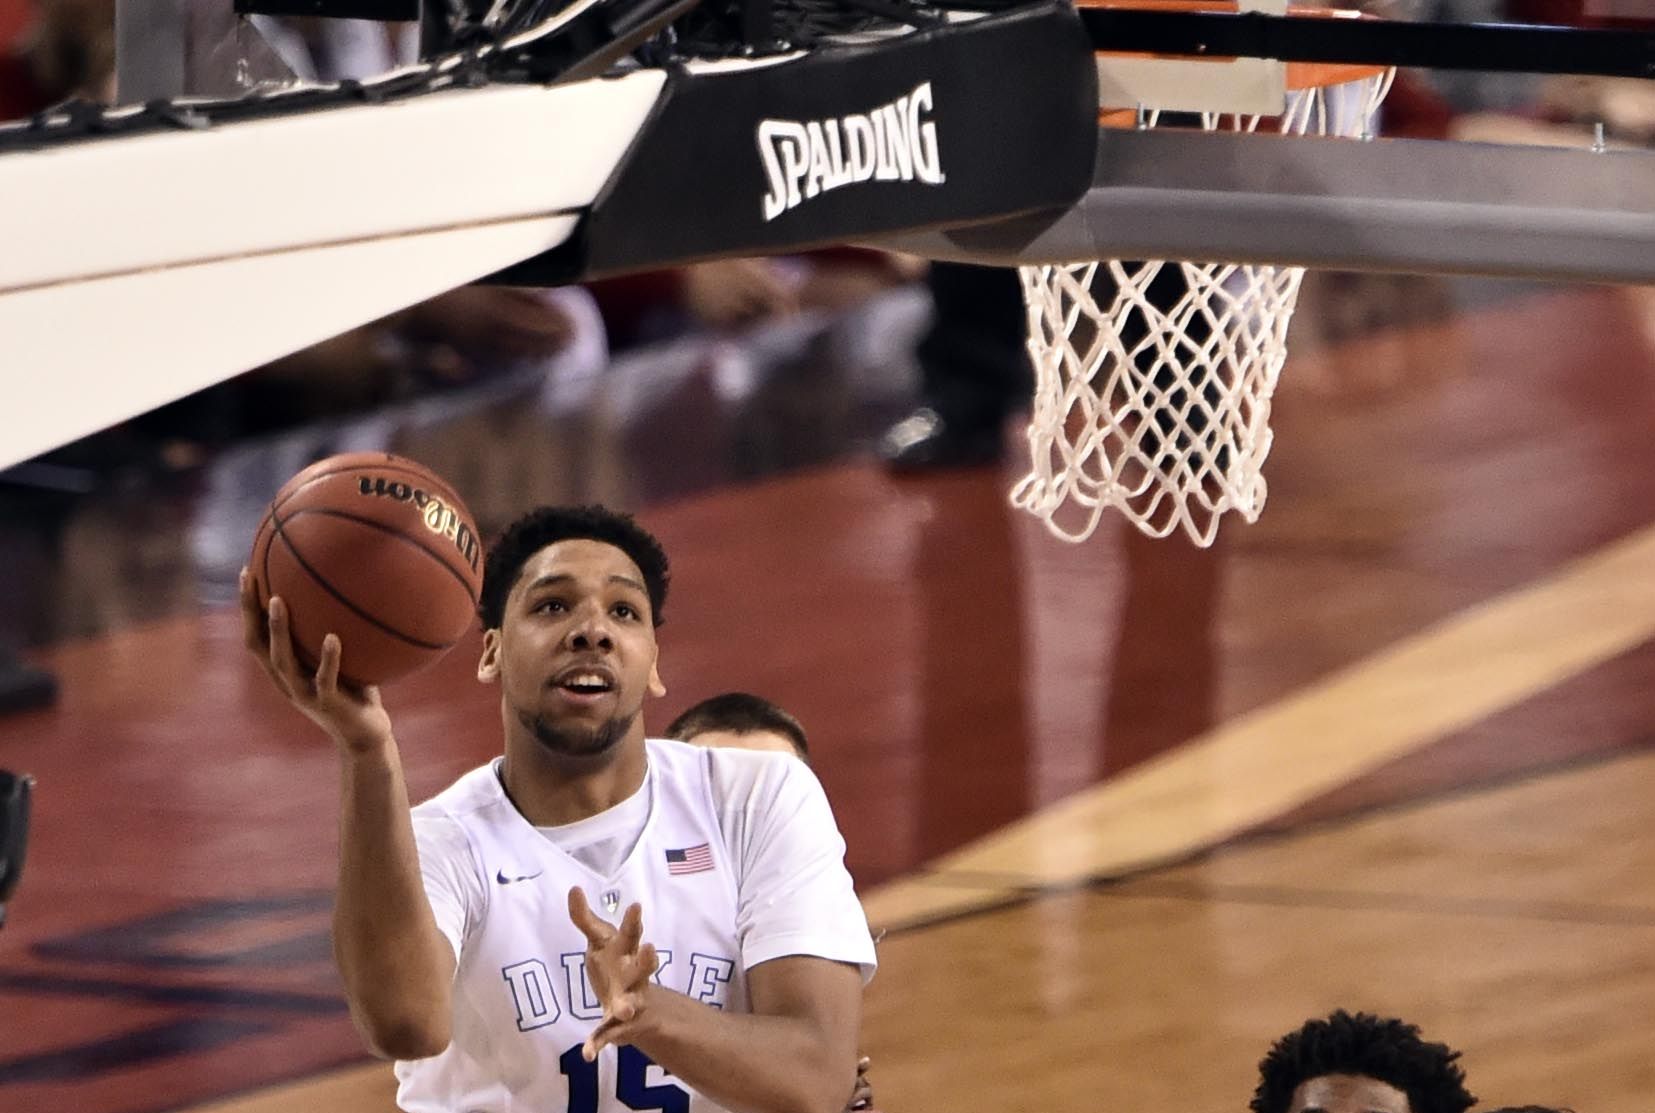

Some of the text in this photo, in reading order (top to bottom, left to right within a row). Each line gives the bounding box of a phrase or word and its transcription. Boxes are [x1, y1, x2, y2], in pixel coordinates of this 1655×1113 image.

[758, 81, 942, 222] SPALDING
[358, 476, 480, 576] Wilson
[502, 949, 735, 1032] DUE
